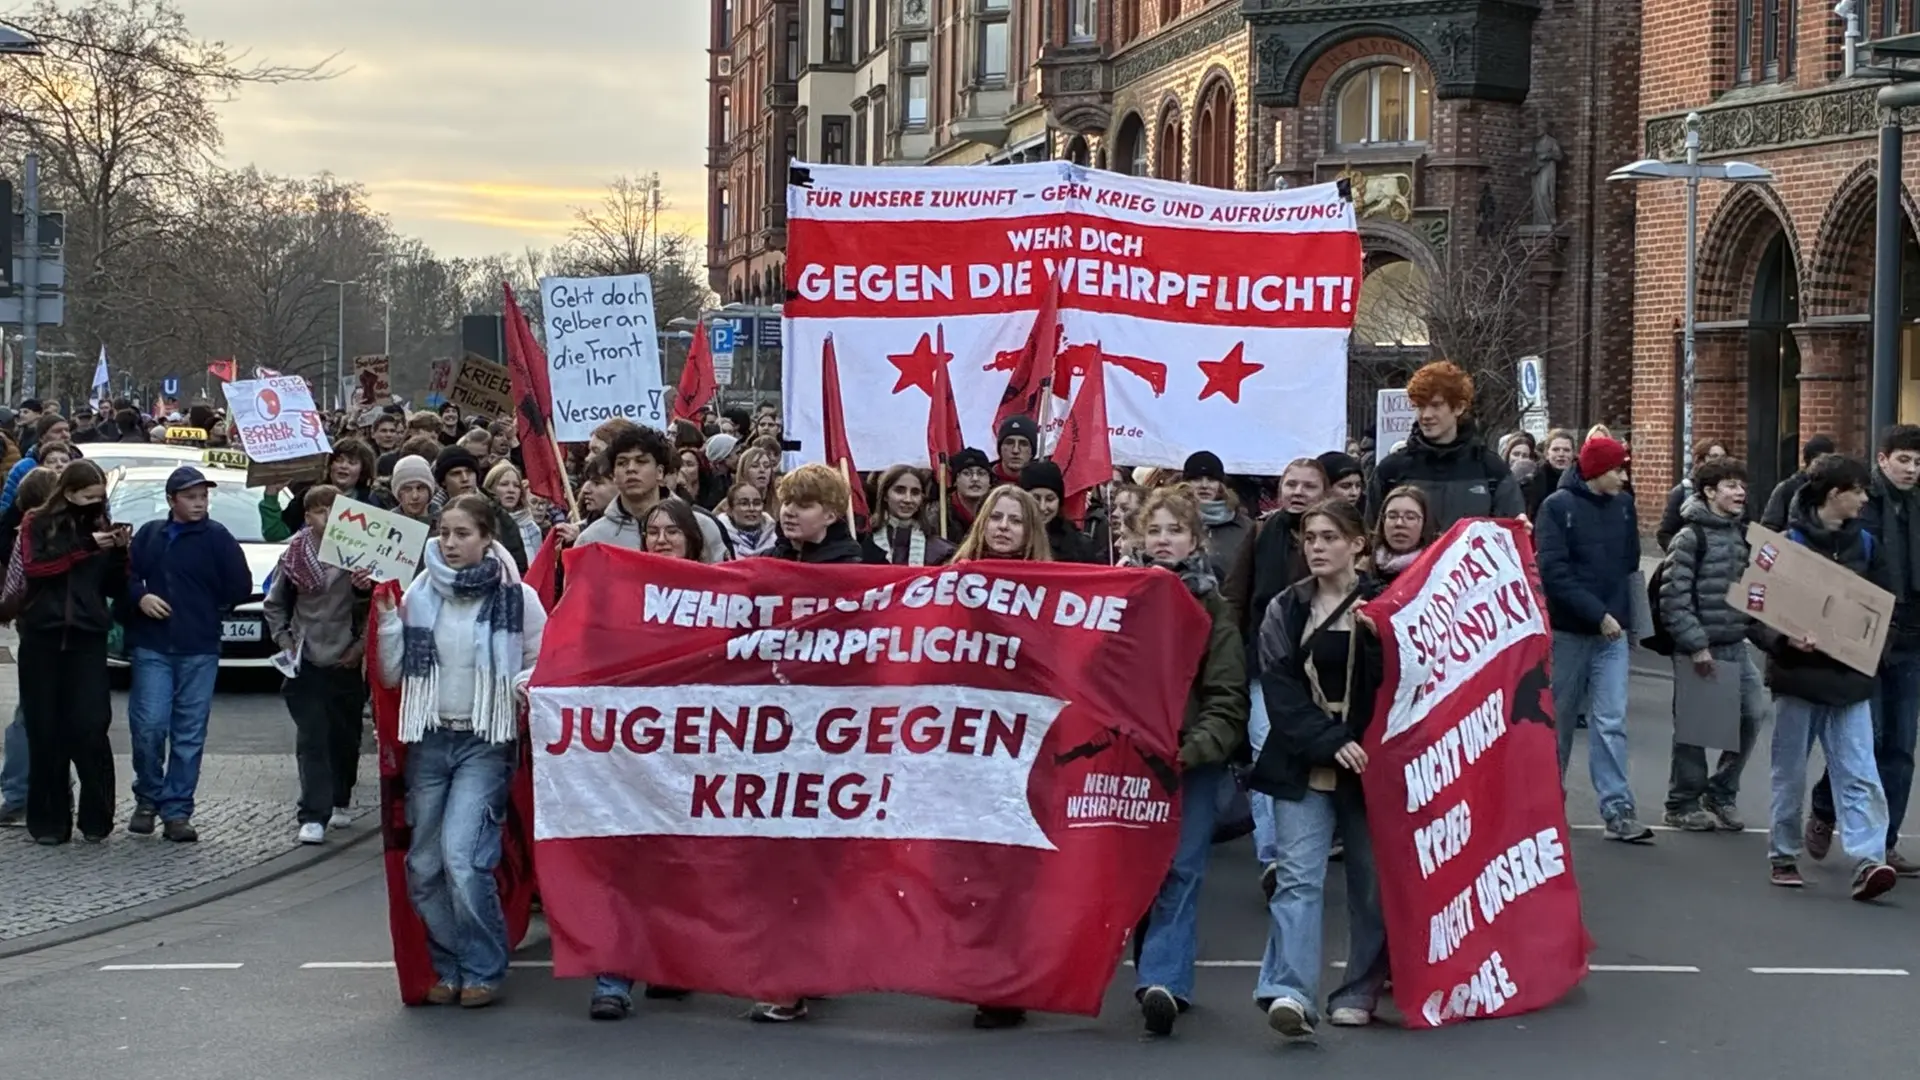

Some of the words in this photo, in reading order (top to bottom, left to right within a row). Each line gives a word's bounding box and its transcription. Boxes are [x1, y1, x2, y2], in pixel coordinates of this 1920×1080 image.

[806, 187, 843, 208] FÜR
[850, 190, 928, 208] UNSERE
[930, 189, 1017, 208] ZUKUNFT
[1041, 183, 1092, 201] GEEN
[1096, 189, 1155, 213] KRIEG
[1163, 200, 1204, 219] UND
[1209, 202, 1345, 223] AUFRÜSTUNG!
[1007, 225, 1073, 252] WEHR
[1080, 227, 1143, 257] DICH
[551, 285, 594, 308] Geht
[602, 282, 647, 305] doch
[797, 263, 954, 301] GEGEN
[968, 260, 1033, 299] DIE
[1043, 257, 1353, 313] WEHRPFLICHT!
[617, 314, 647, 327] an
[553, 345, 586, 370] die
[584, 332, 643, 361] Front
[164, 379, 178, 394] U
[459, 363, 512, 394] KRIEG
[586, 369, 617, 386] Ihr
[173, 430, 201, 438] TAXI
[242, 421, 292, 437] SCHUL
[245, 427, 298, 445] STREIK
[211, 449, 244, 464] TAXI
[338, 507, 403, 544] Mein
[376, 544, 393, 557] ist
[643, 583, 783, 627] WEHRT
[902, 571, 1047, 620] GEGEN
[1053, 590, 1128, 632] DIE
[230, 623, 255, 636] 164
[727, 625, 1021, 670] WEHRPFLICHT!
[545, 705, 794, 756] JUGEND
[815, 706, 1028, 758] GEGEN
[1404, 727, 1461, 813] NICHT
[690, 772, 893, 821] KRIEG!
[1083, 773, 1120, 795] NEIN
[1122, 776, 1150, 799] ZUR
[1066, 797, 1170, 823] WEHRPFLICHT!
[1413, 799, 1472, 880] KRIEG
[1428, 885, 1475, 964] NICHT
[1475, 827, 1566, 924] UNSERE
